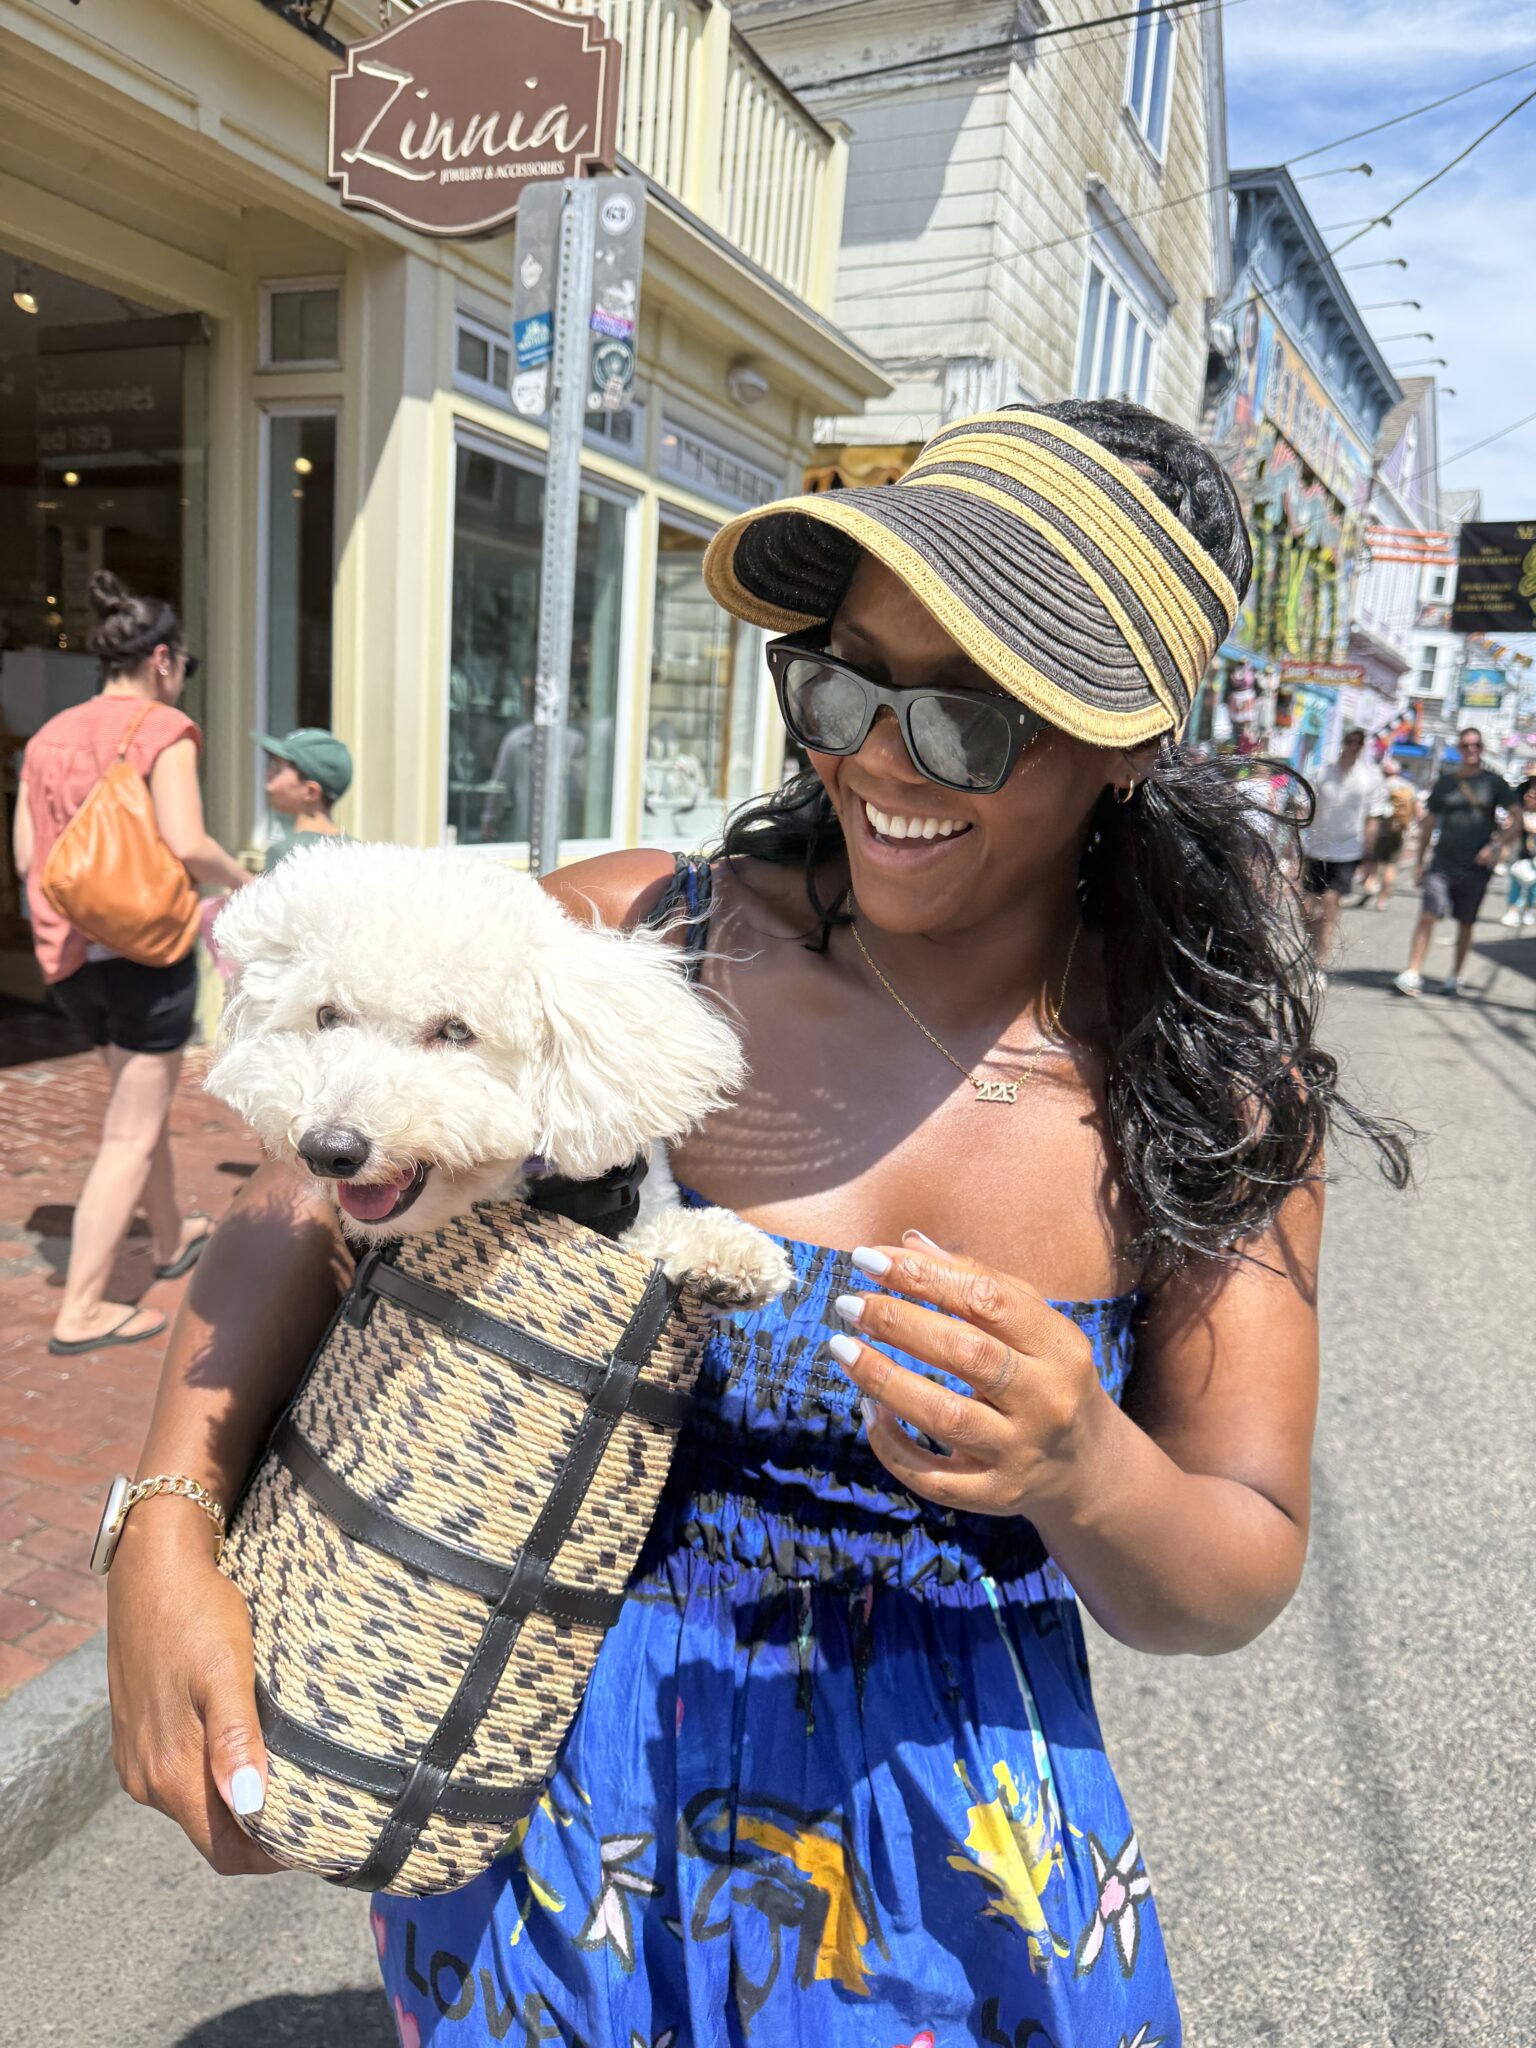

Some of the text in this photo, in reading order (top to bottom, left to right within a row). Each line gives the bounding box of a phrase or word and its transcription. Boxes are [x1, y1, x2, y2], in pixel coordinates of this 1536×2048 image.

[340, 60, 589, 181] Zinnia
[439, 160, 566, 185] JEWELRY & ACCESSORIES
